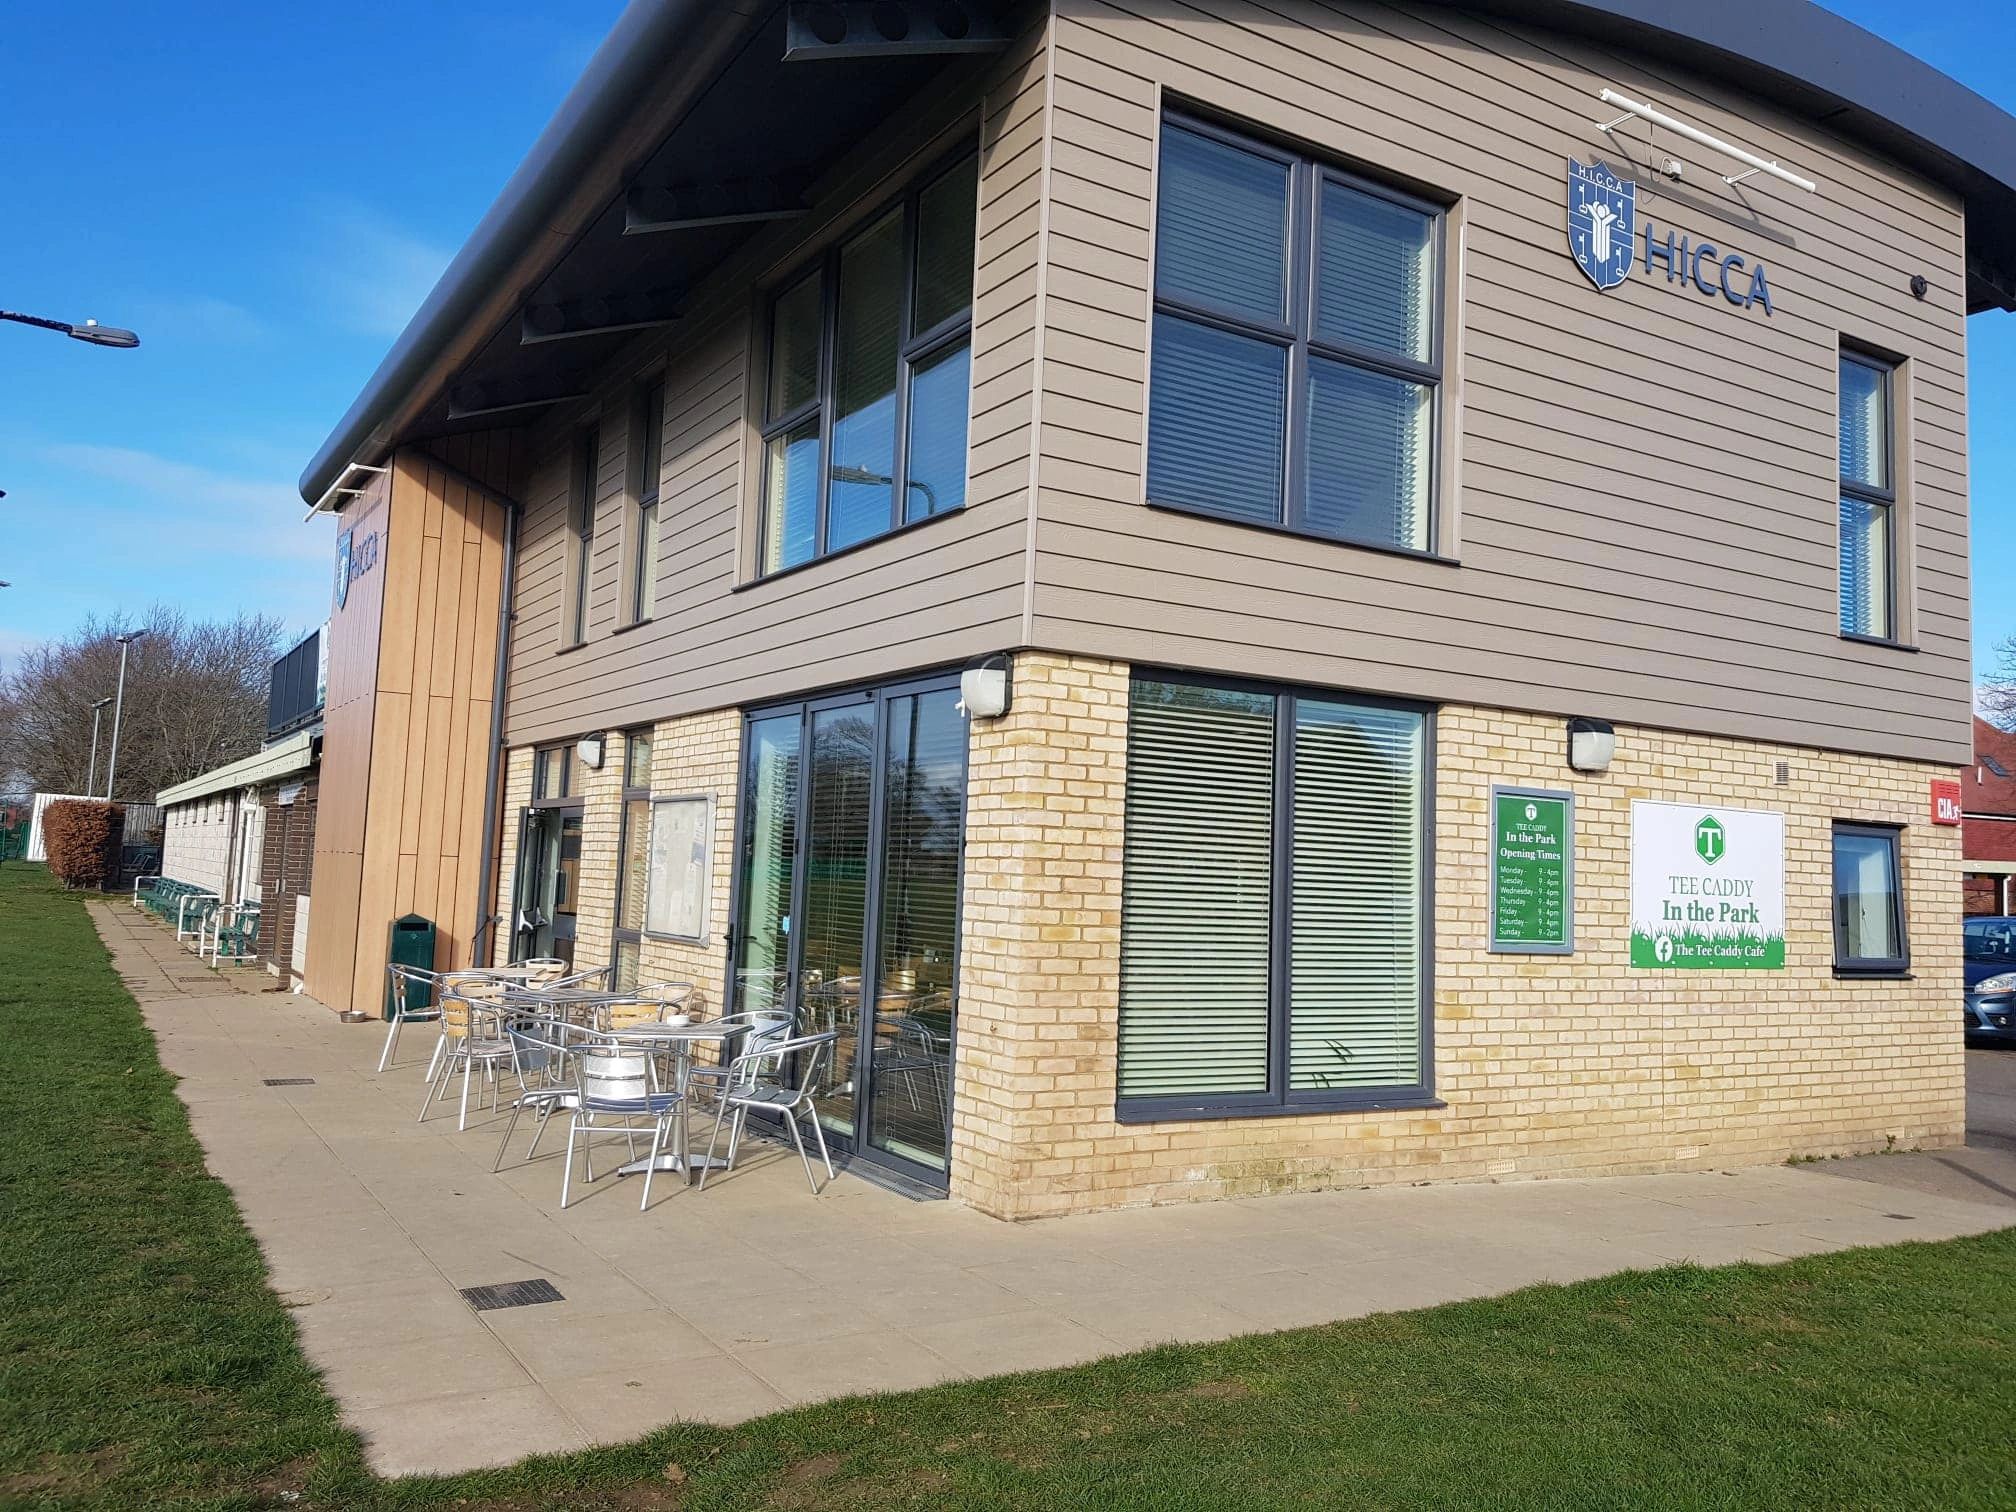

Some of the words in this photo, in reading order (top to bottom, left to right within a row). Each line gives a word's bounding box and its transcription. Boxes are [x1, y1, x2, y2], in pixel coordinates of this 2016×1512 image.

[1645, 223, 1773, 317] HICCA
[1506, 832, 1516, 841] In
[1519, 832, 1533, 842] the
[1536, 833, 1556, 844] Park
[1698, 827, 1722, 857] T
[1500, 848, 1536, 860] Opening
[1536, 850, 1560, 859] Times
[1500, 866, 1523, 876] Monday
[1500, 876, 1523, 886] Tuesday
[1668, 876, 1699, 894] TEE
[1702, 878, 1754, 897] CADDY
[1500, 907, 1518, 916] Friday
[1662, 900, 1682, 920] In
[1687, 900, 1714, 921] the
[1719, 902, 1760, 923] Park
[1500, 917, 1524, 927] Saturday
[1500, 928, 1520, 937] Sunday
[1675, 944, 1693, 955] The
[1695, 944, 1712, 956] Tee
[1714, 945, 1743, 959] Caddy
